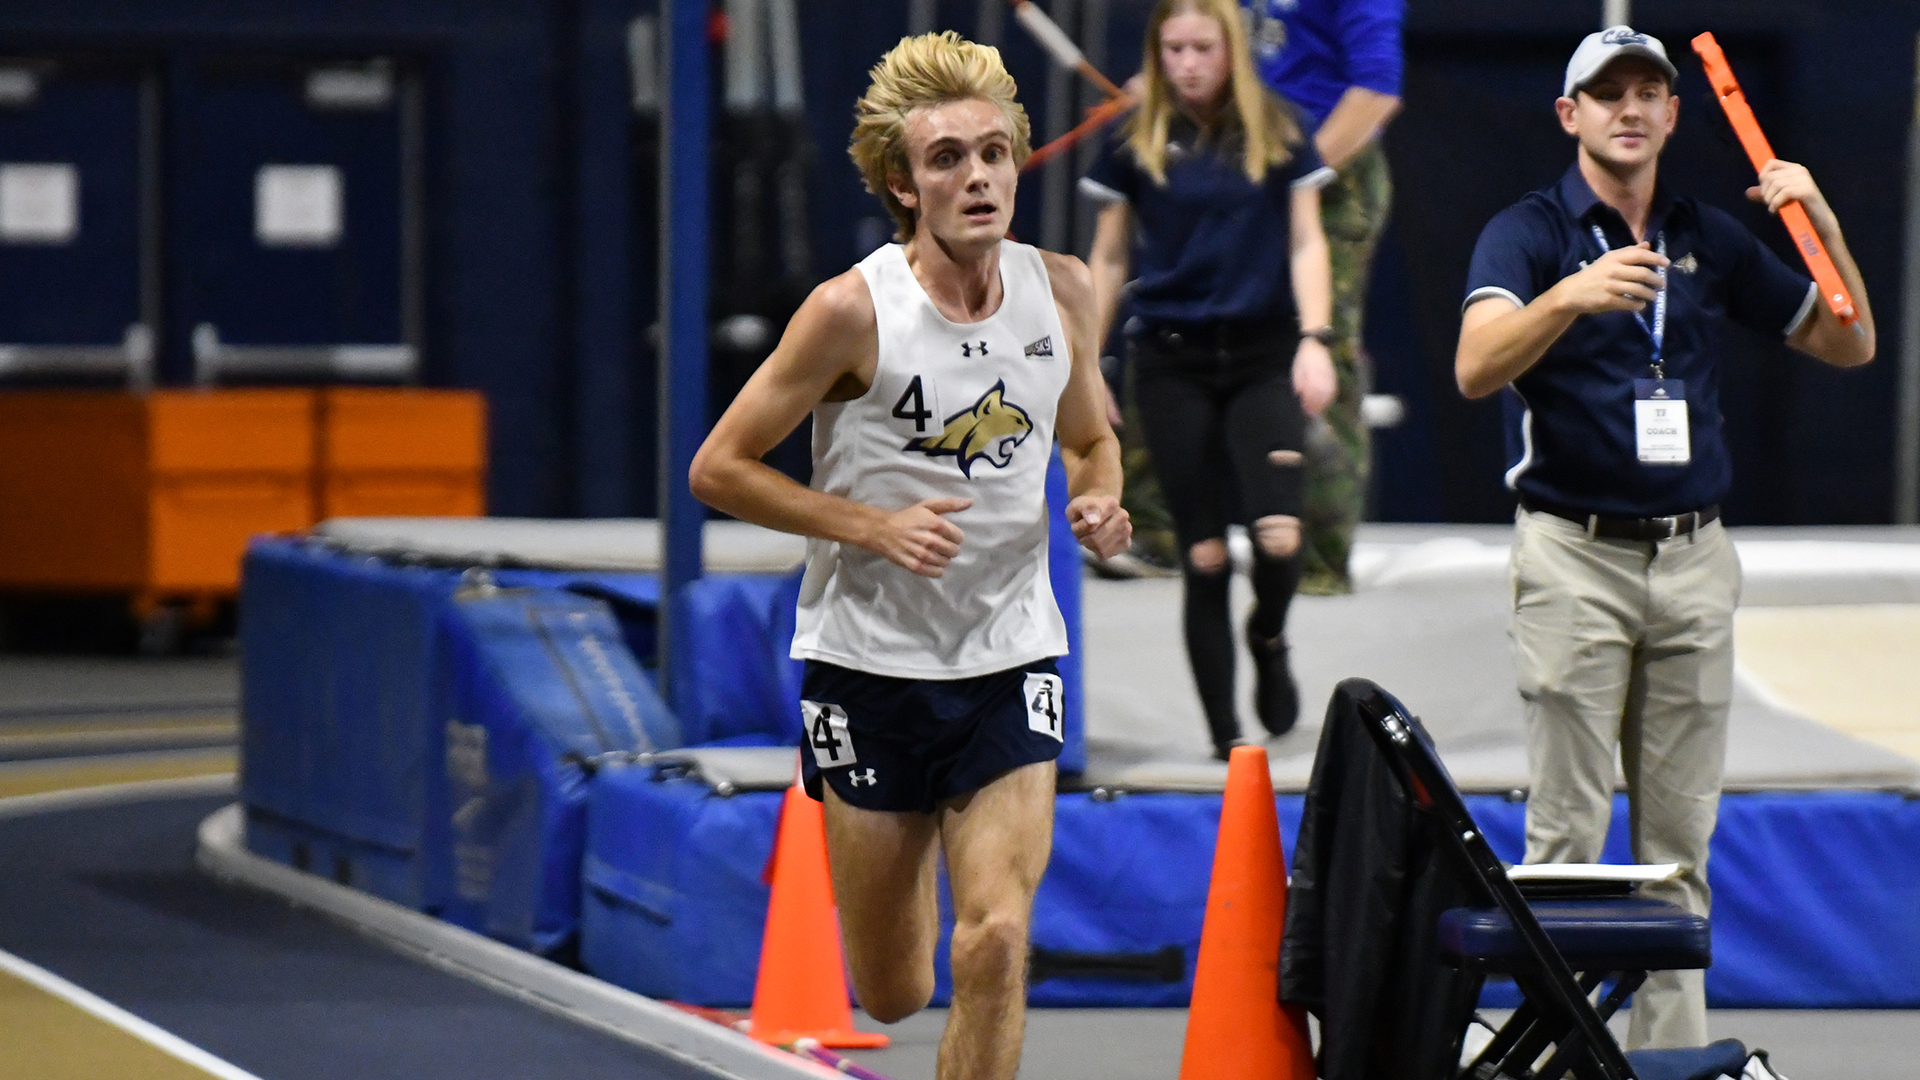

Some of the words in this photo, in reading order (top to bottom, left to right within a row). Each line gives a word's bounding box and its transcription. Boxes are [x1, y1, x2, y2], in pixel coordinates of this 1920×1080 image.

[1653, 291, 1665, 335] MONTANA
[1035, 337, 1051, 352] SKY
[892, 374, 932, 432] 4
[1646, 427, 1677, 435] COACH
[1031, 679, 1058, 732] 4
[813, 706, 842, 761] 4
